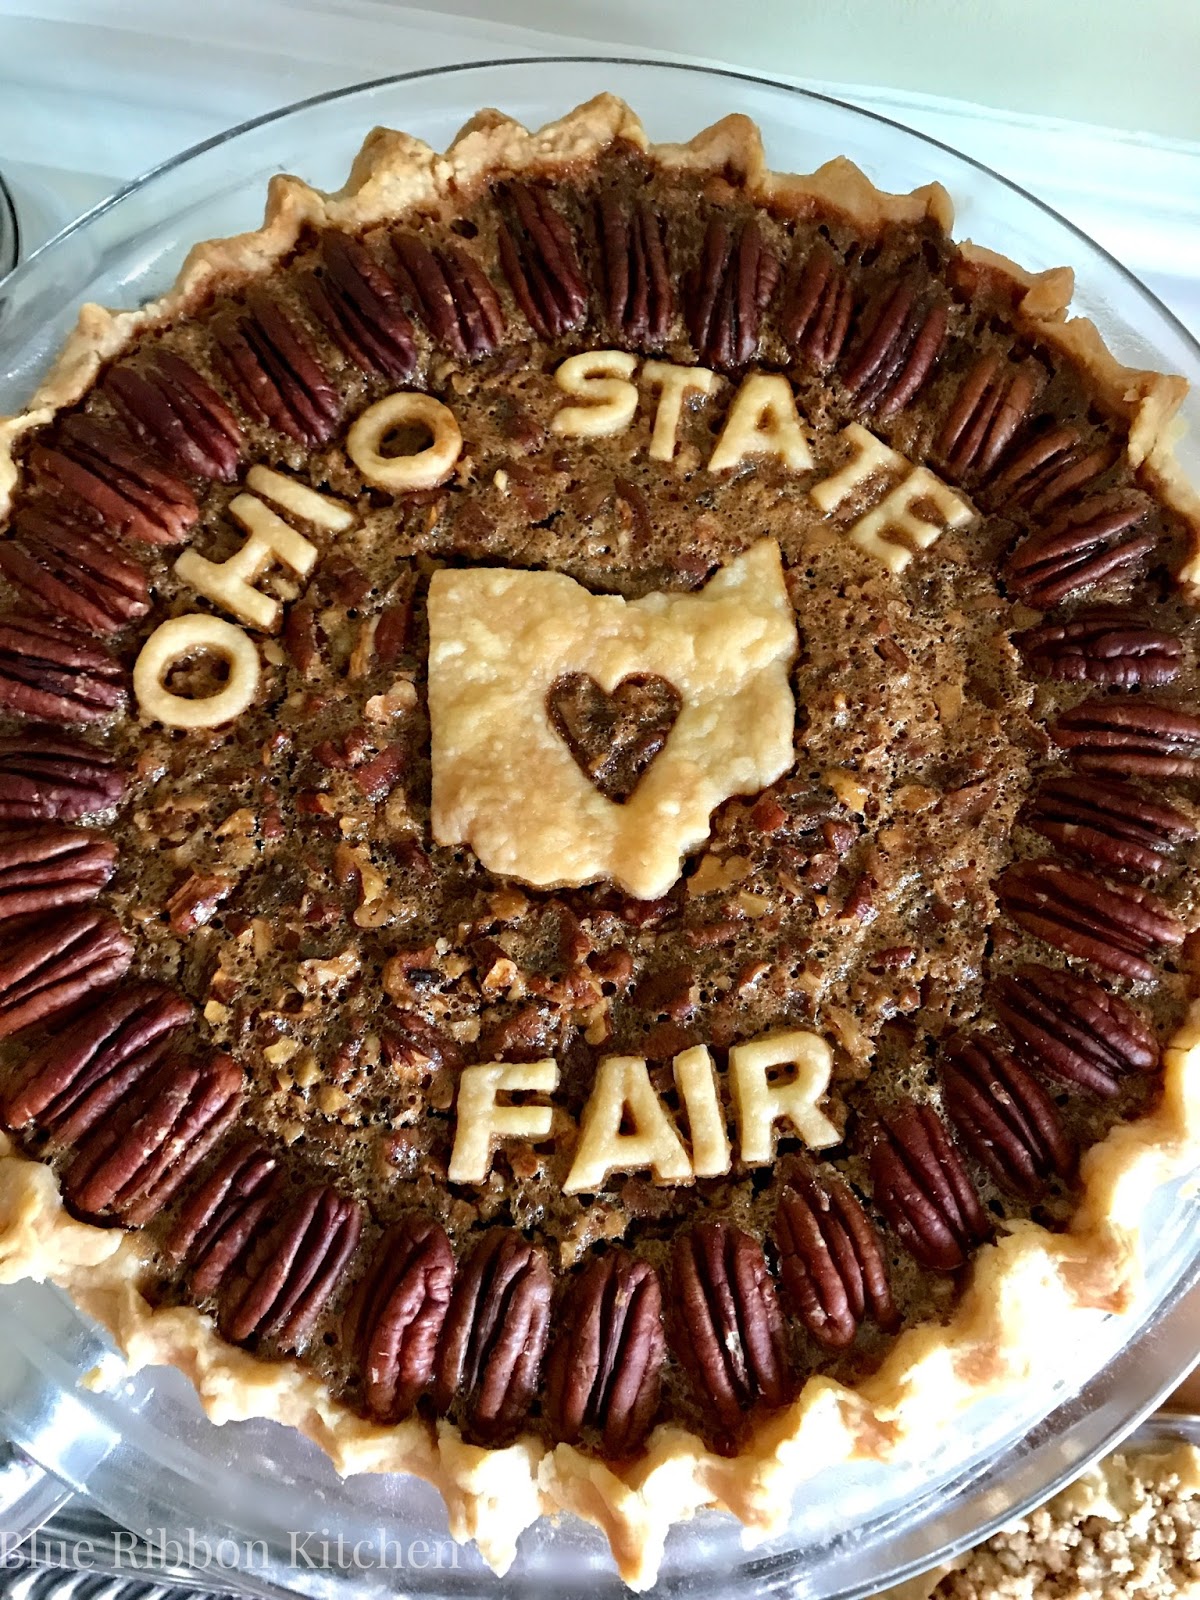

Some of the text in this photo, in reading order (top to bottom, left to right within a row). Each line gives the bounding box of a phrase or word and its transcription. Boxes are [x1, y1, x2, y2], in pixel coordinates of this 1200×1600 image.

[133, 349, 974, 728] OHIO STATE
[448, 1030, 843, 1195] FAIR
